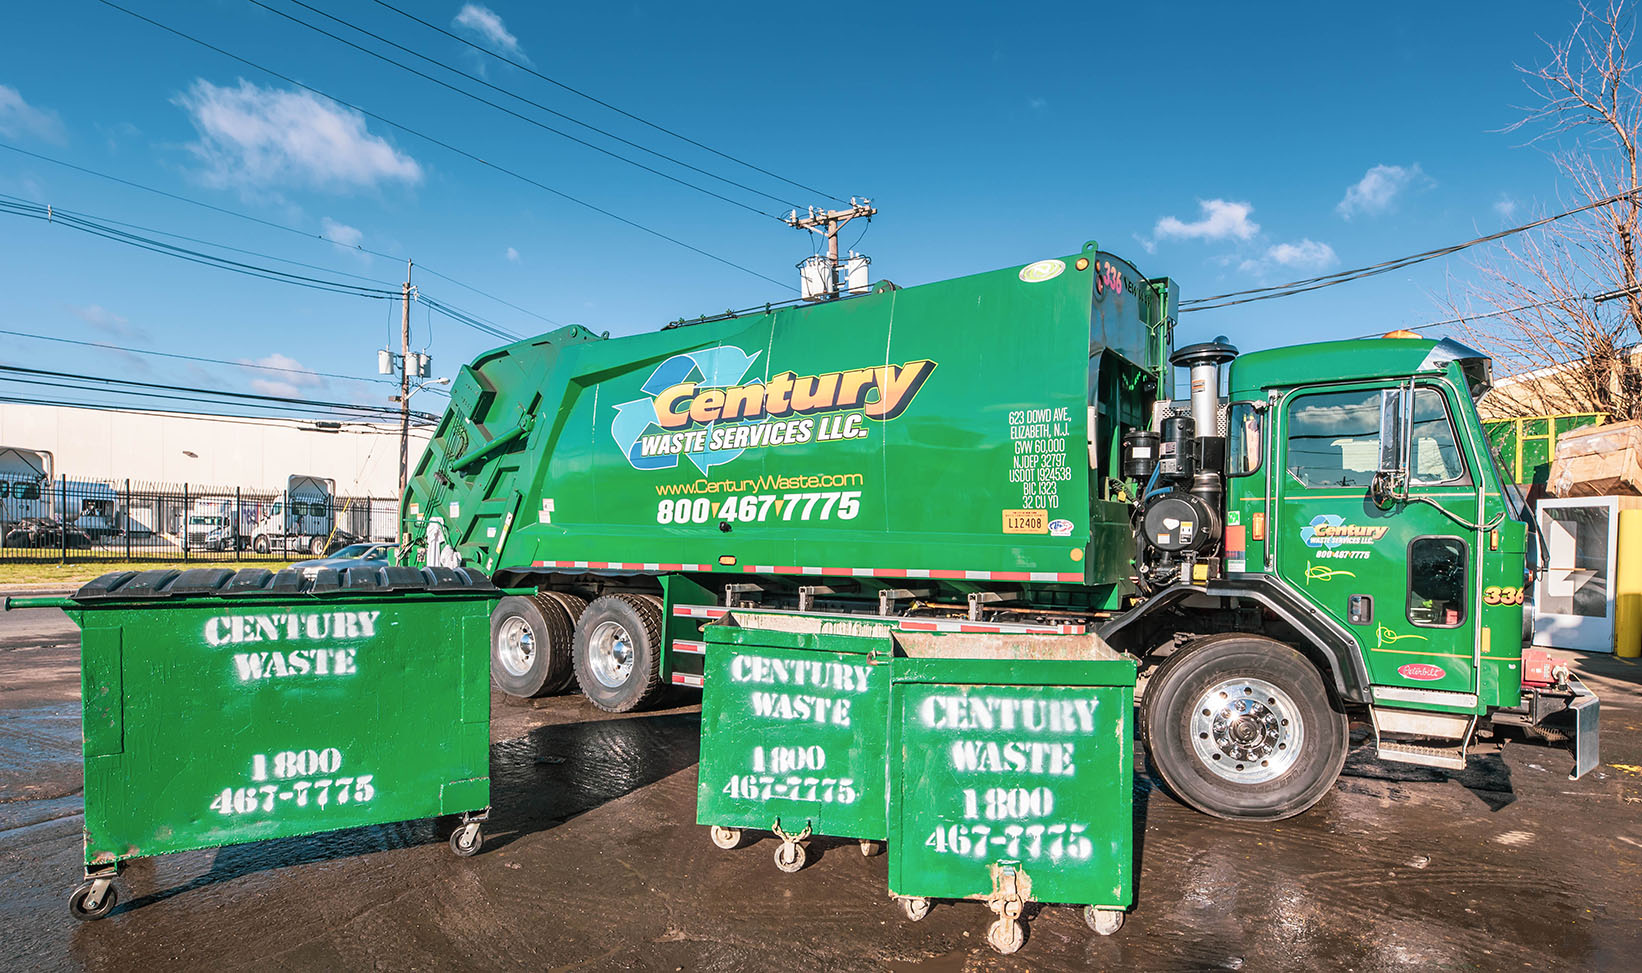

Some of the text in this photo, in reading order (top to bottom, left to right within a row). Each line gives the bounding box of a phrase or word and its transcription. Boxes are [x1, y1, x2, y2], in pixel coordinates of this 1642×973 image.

[1103, 261, 1122, 294] 336
[654, 360, 937, 431] Century
[1008, 407, 1072, 425] 623 DOWD AVE,
[641, 413, 868, 457] WASTE SERVICES LLC.
[1010, 422, 1070, 440] ELIZABETH, N.J.
[1014, 438, 1065, 454] GVW 60,000
[1009, 466, 1071, 482] USDOT 1924538
[1013, 453, 1067, 469] NJDEP 32797
[655, 472, 863, 497] www.CenturyWaste.com
[1023, 481, 1057, 495] BIC 1323
[1022, 495, 1059, 509] 32 CU YD
[1008, 517, 1042, 529] L12408
[1313, 523, 1390, 540] Century
[1483, 586, 1524, 606] 336
[205, 611, 380, 645] CENTURY
[234, 648, 357, 681] WASTE
[730, 654, 873, 692] CENTURY
[1402, 664, 1442, 677] Peterbilt
[751, 691, 851, 726] WASTE
[920, 696, 1099, 732] CENTURY
[951, 740, 1075, 776] WASTE
[210, 775, 375, 814] 467-7775
[722, 775, 856, 804] 467-7775
[925, 823, 1093, 859] 467-7775
